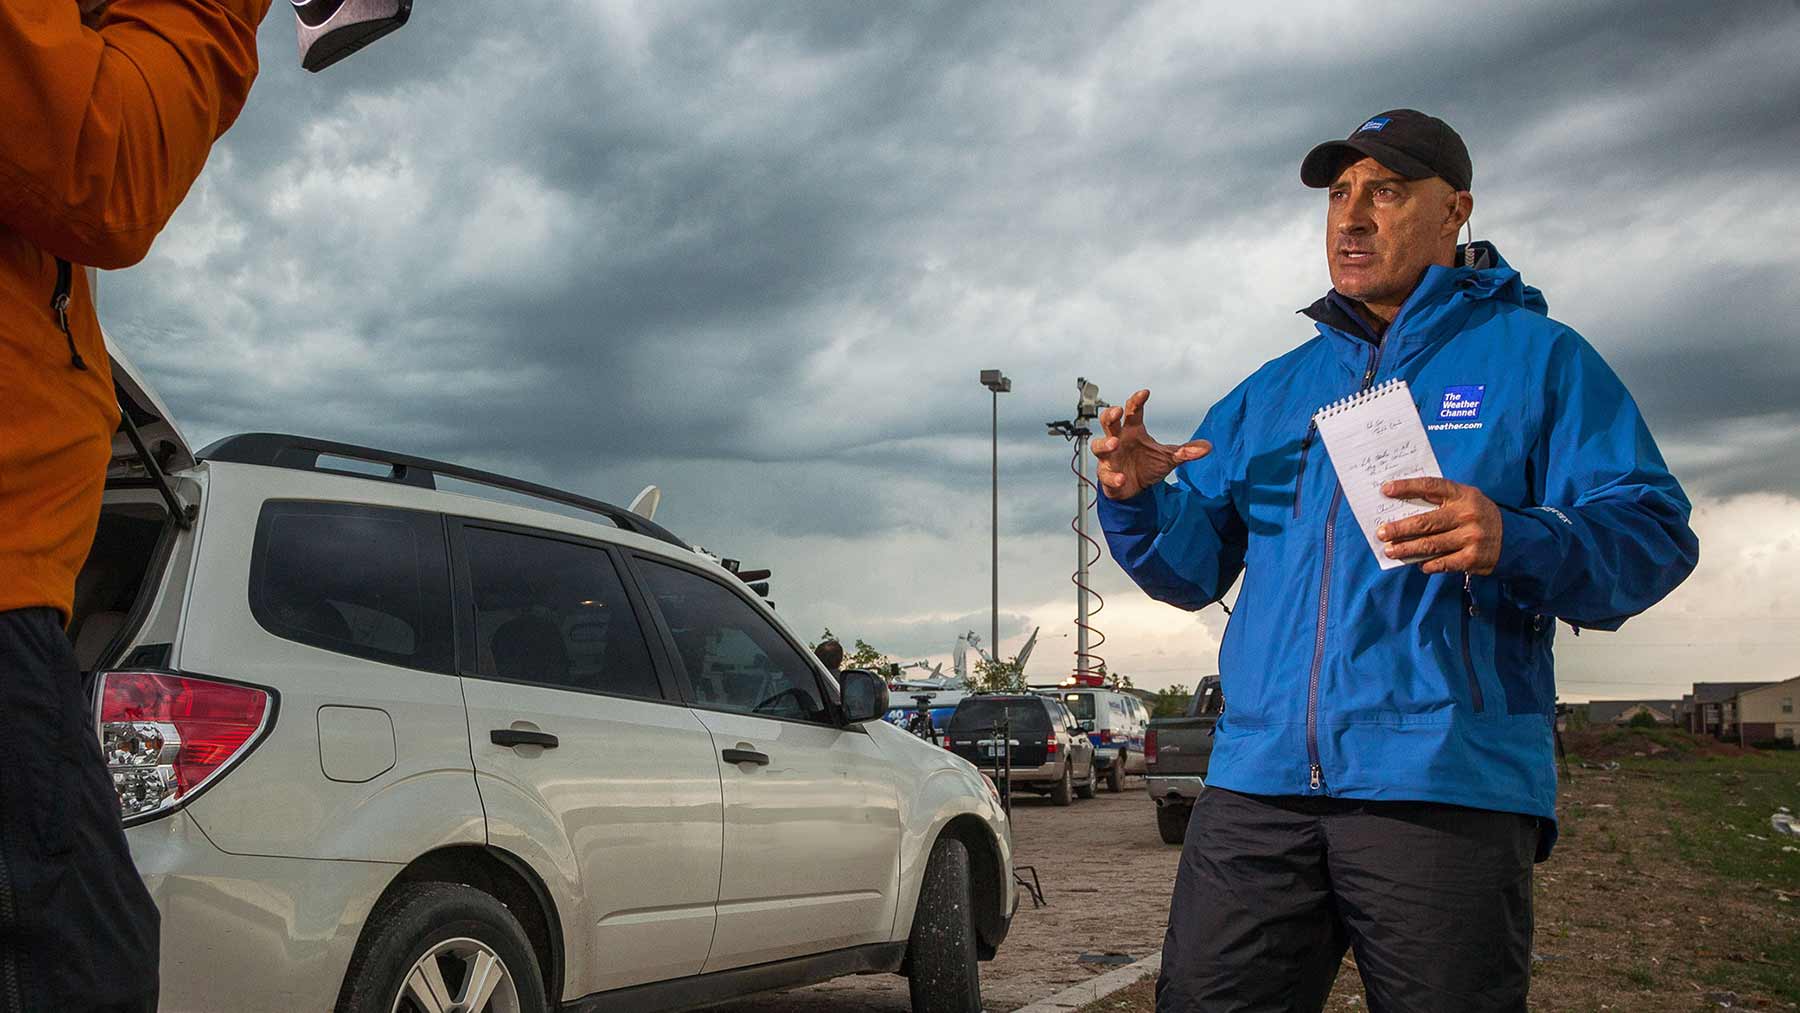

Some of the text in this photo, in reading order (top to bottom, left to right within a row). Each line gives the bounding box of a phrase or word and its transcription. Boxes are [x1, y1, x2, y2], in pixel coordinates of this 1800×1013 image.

[1445, 393, 1461, 401] The
[1443, 400, 1480, 409] Weather
[1440, 408, 1476, 417] Channel
[1427, 422, 1483, 431] weather.com
[888, 709, 904, 720] 40
